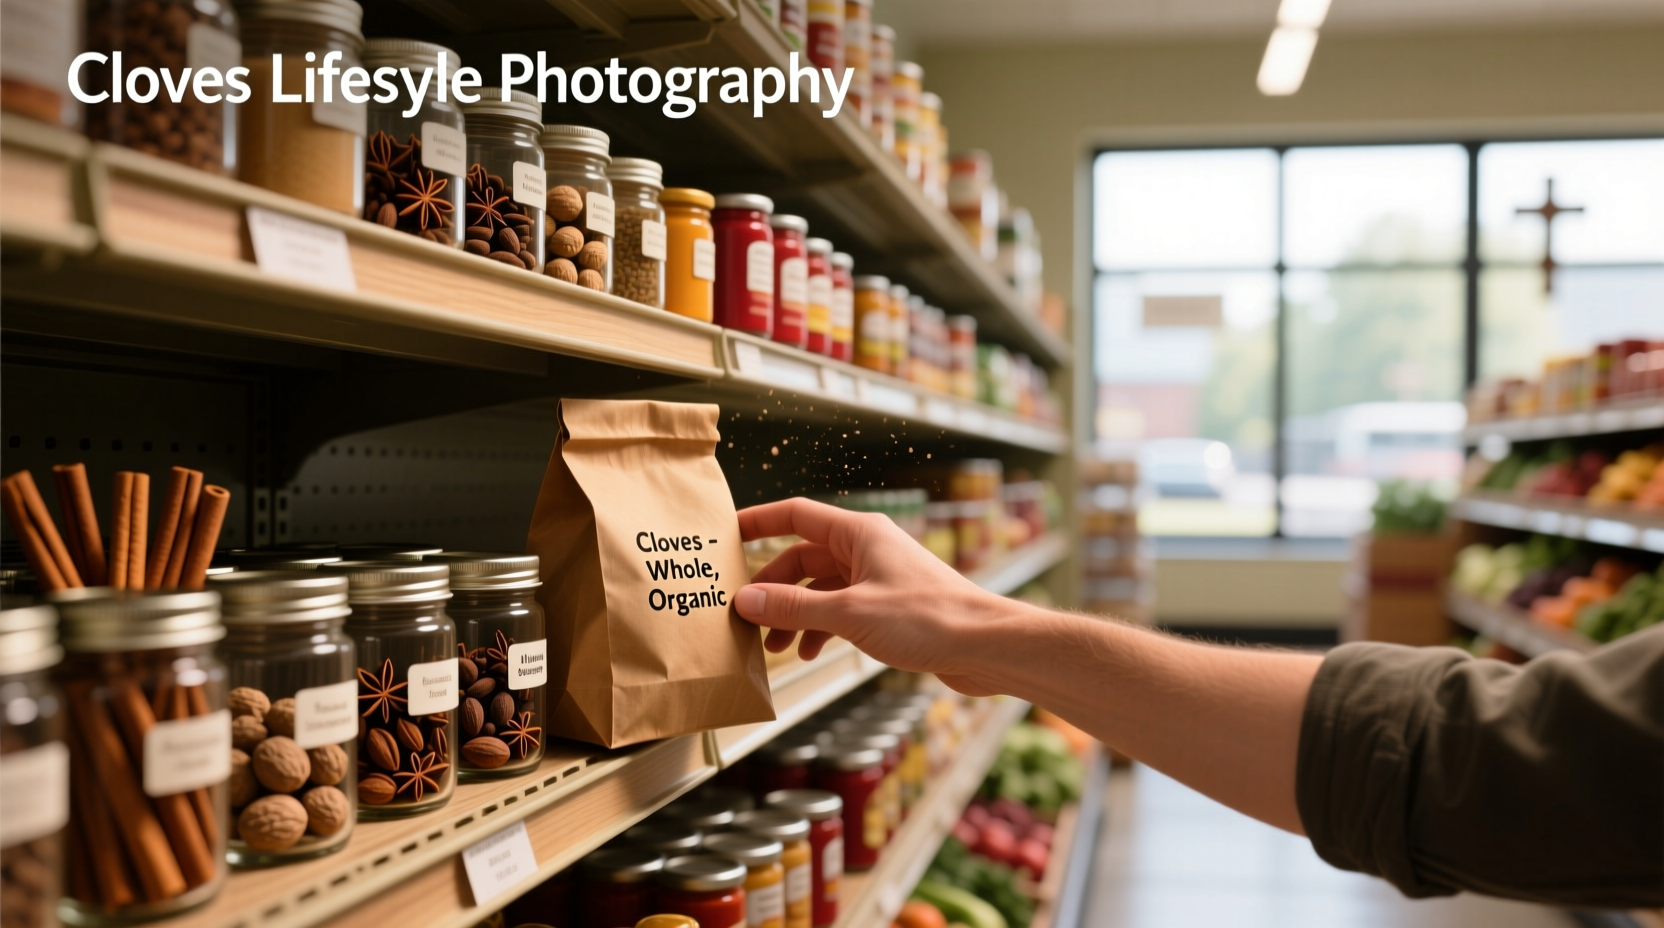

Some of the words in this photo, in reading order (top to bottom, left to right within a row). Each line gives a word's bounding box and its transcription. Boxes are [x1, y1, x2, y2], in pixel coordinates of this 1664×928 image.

[636, 531, 703, 553] Cloves
[645, 557, 720, 582] Whole,
[648, 584, 727, 617] Organic
